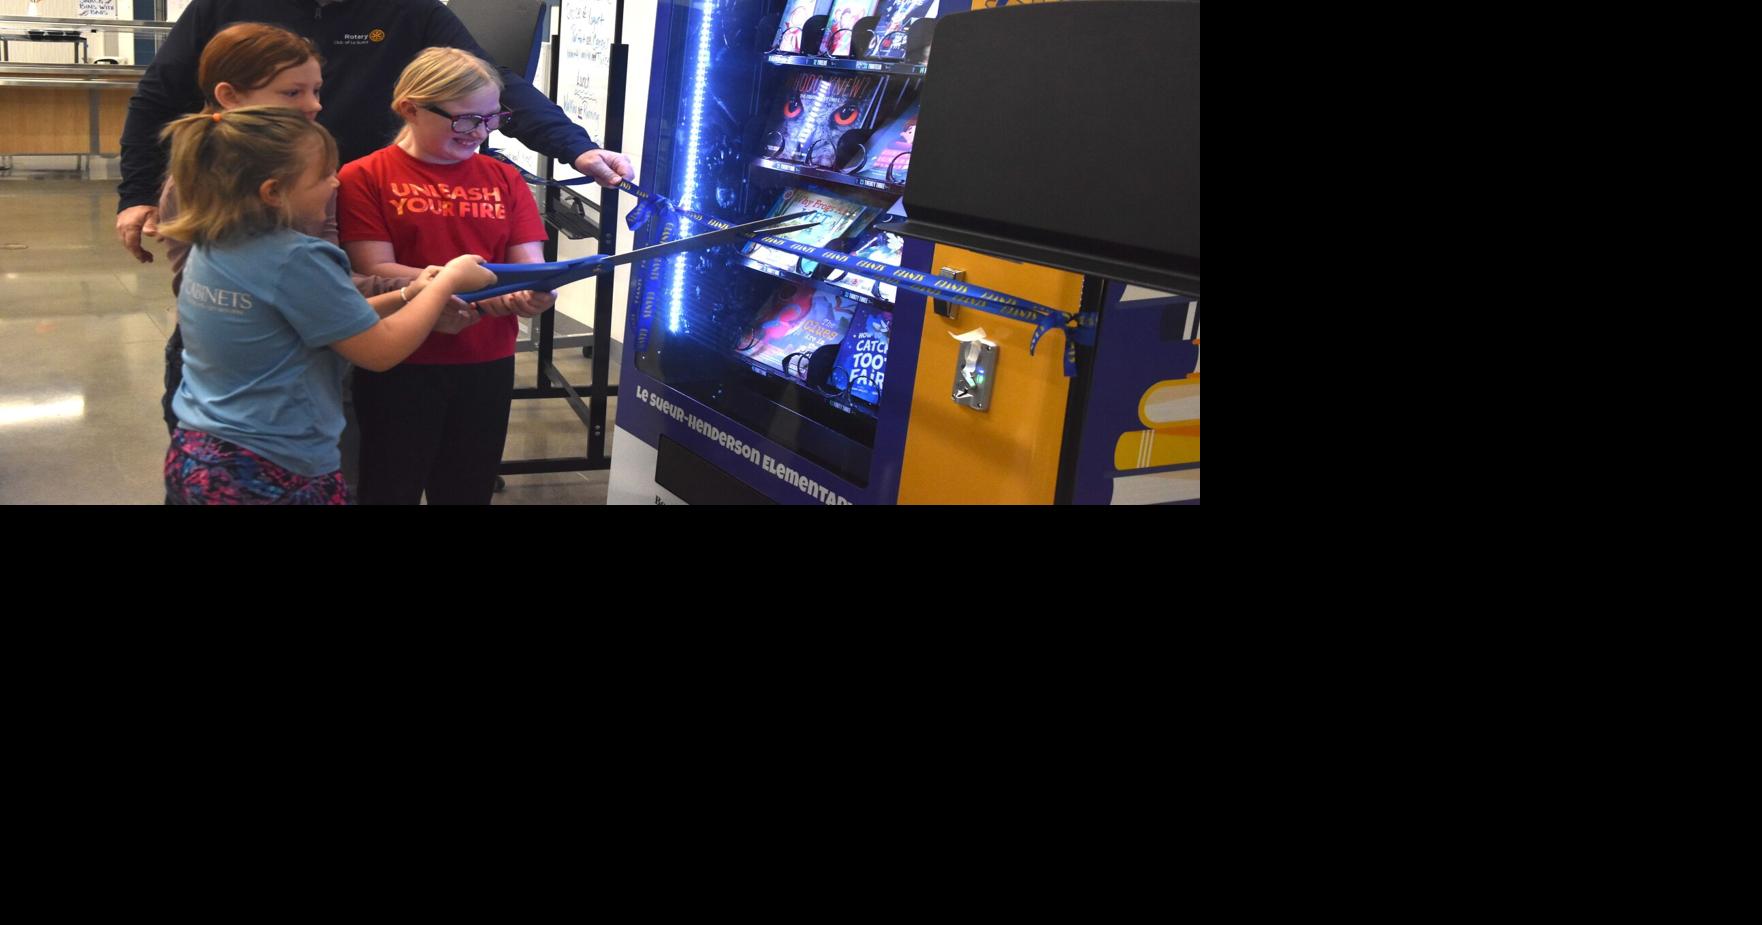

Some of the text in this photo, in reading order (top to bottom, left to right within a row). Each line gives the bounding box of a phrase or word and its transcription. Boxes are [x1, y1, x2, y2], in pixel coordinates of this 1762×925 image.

[390, 183, 502, 202] UNLEASH
[389, 197, 506, 219] YOUR FIRE
[800, 197, 813, 207] hy
[812, 199, 834, 212] Frog
[893, 269, 924, 281] GIANTS
[934, 279, 968, 293] GIANTS
[853, 353, 888, 370] TOO
